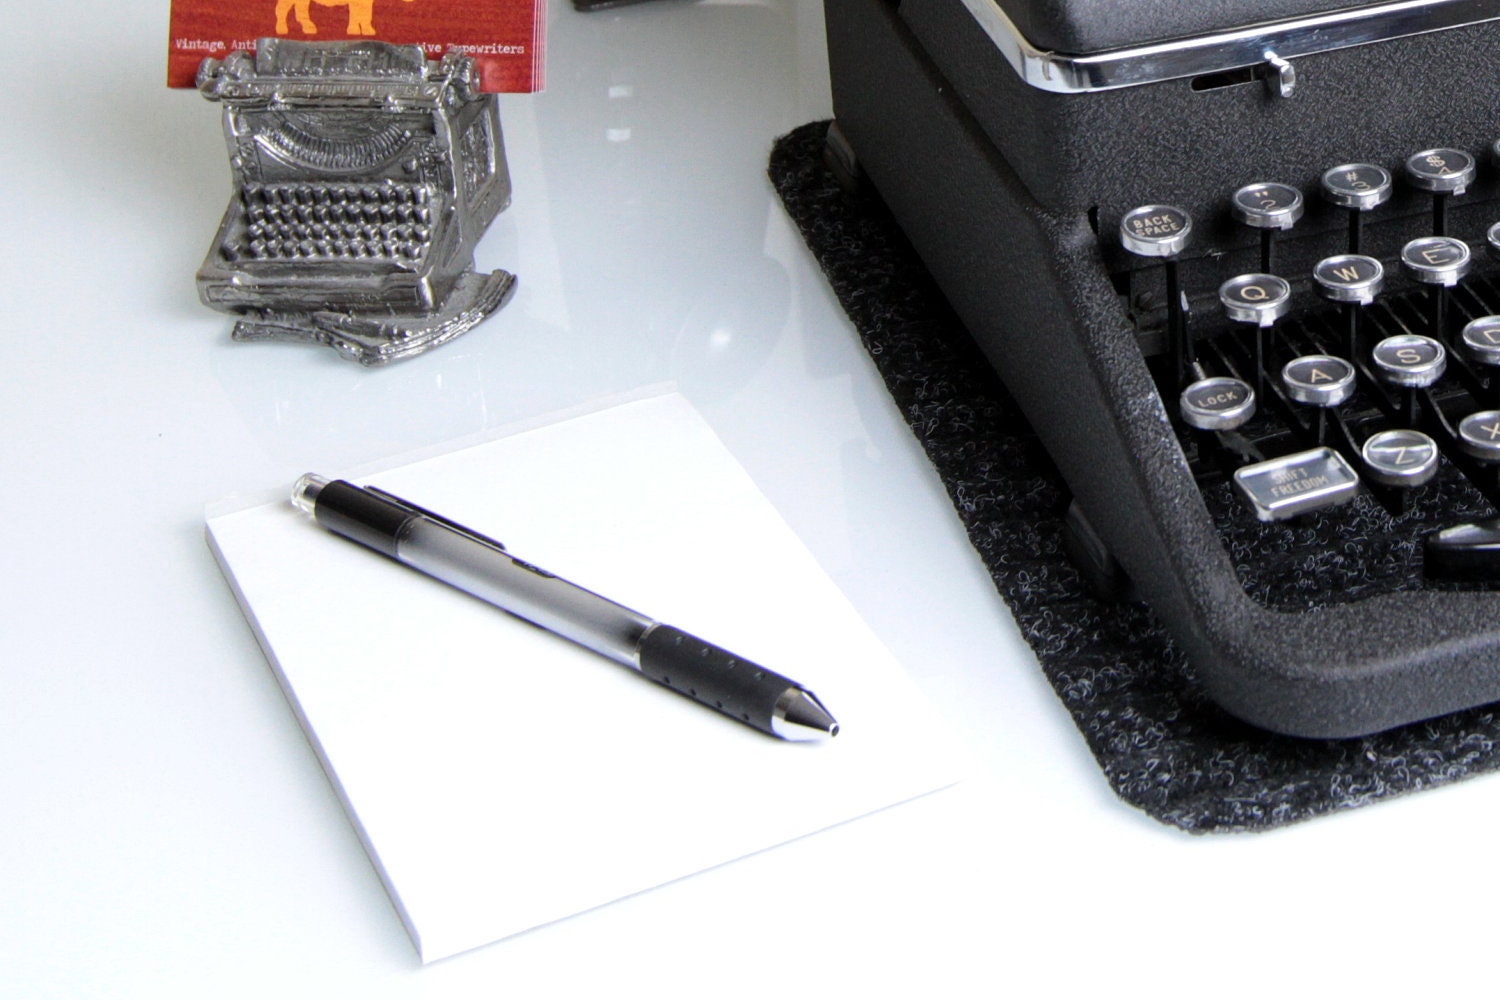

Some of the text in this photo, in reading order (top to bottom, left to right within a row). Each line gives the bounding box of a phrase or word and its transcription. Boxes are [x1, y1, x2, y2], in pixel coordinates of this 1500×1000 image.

[231, 40, 257, 50] Anti
[1133, 214, 1172, 229] BACK
[1135, 222, 1180, 237] SPACE
[1421, 248, 1450, 265] E
[1333, 265, 1360, 282] W
[1240, 285, 1270, 300] Q
[1396, 348, 1421, 364] S
[1310, 367, 1334, 384] A
[1198, 391, 1238, 408] LOCK
[1275, 467, 1308, 484] SHIFT
[1270, 475, 1328, 498] FREEDOM
